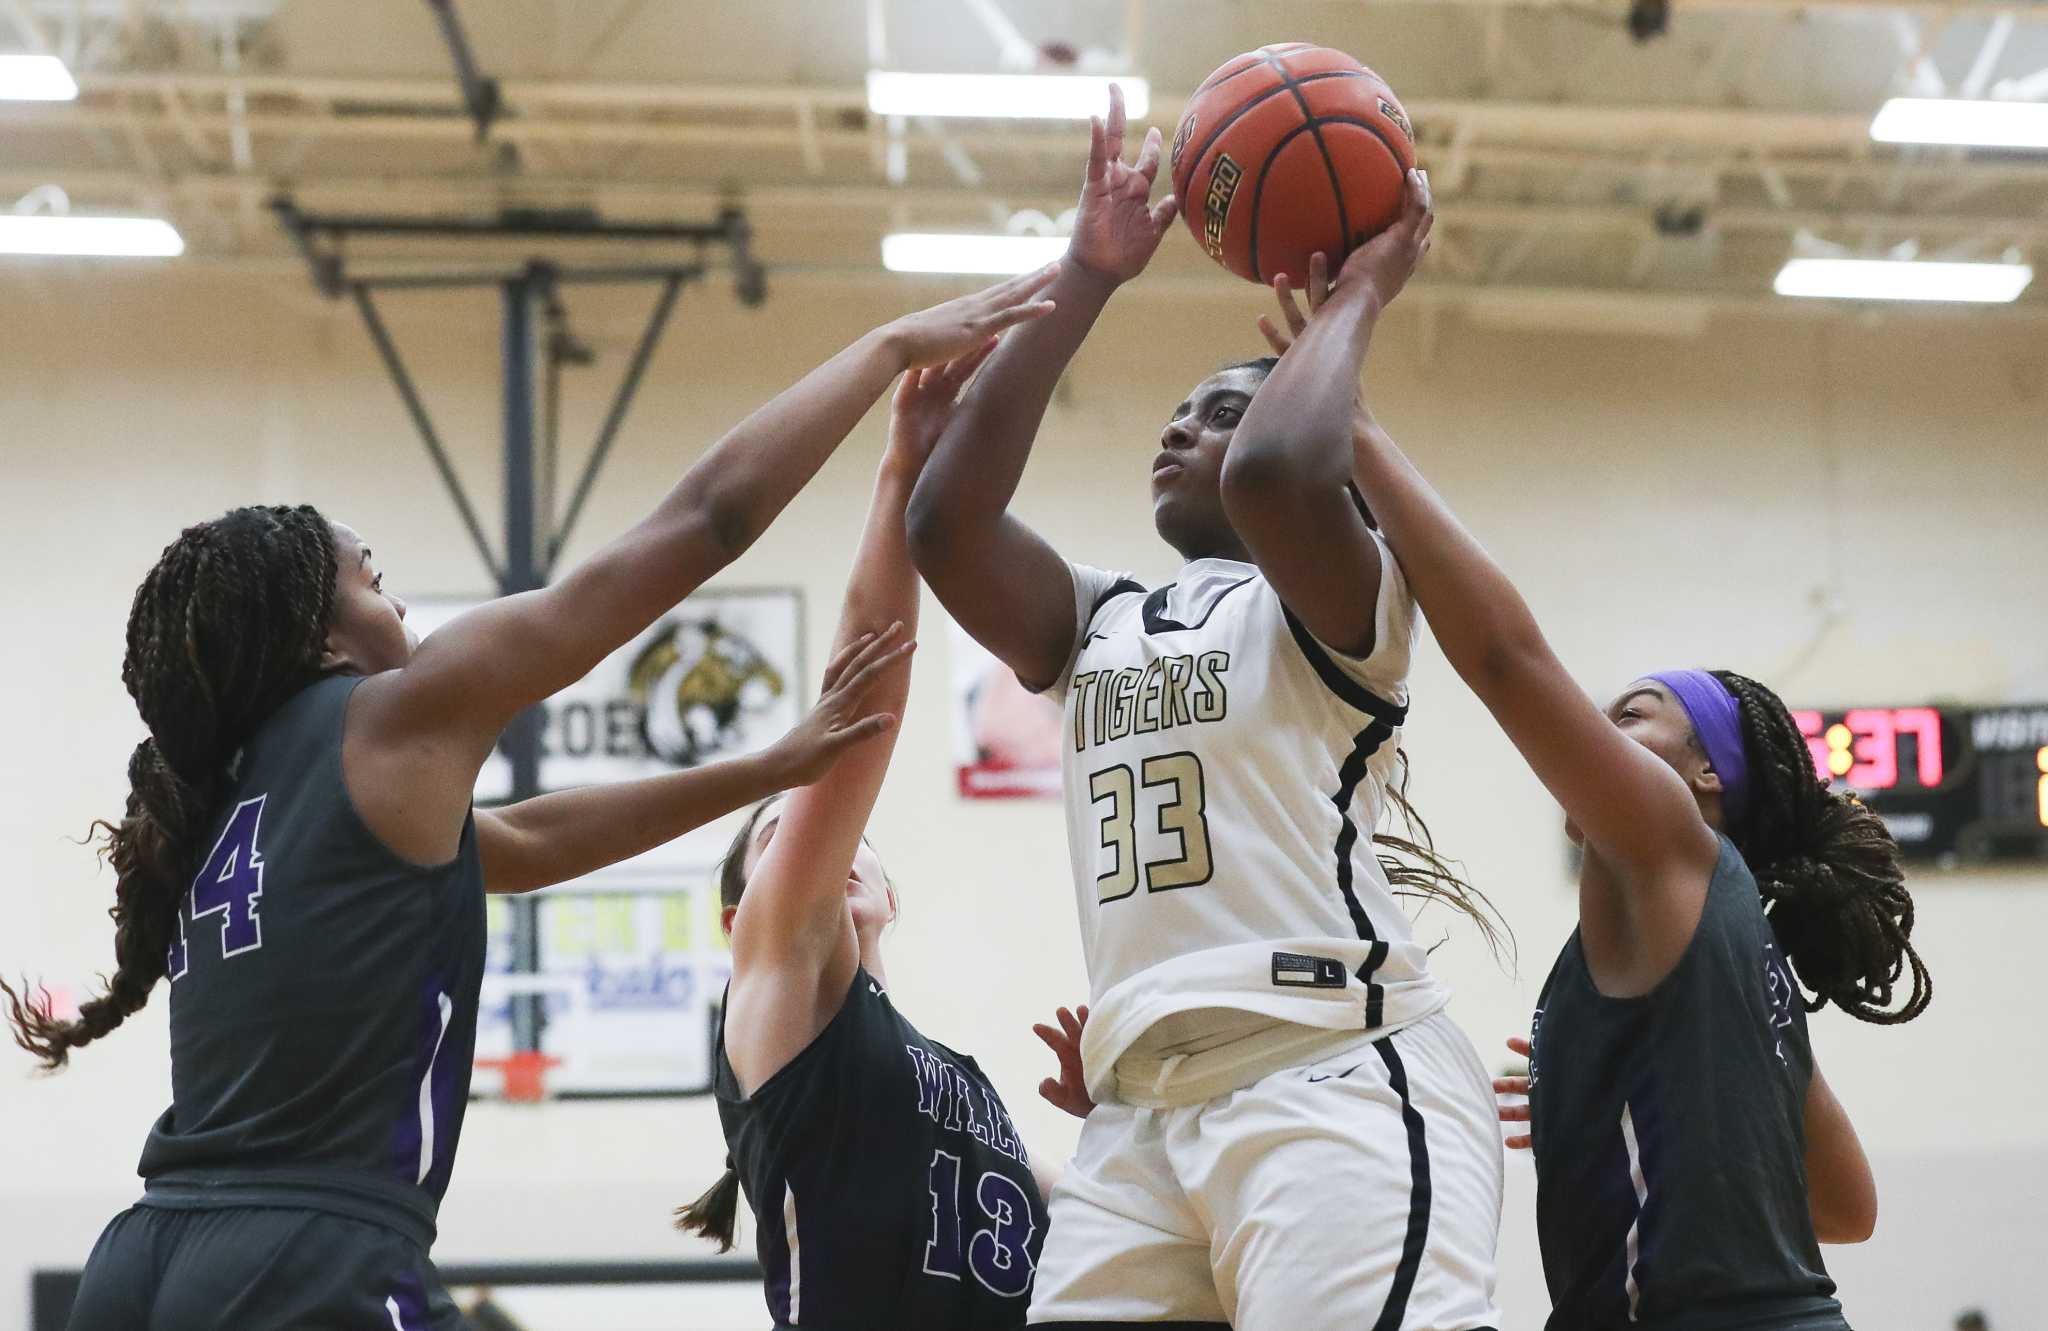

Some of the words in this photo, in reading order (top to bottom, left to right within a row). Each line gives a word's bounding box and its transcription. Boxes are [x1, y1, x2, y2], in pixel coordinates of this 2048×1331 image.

[1073, 650, 1230, 752] TIGERS
[1088, 750, 1214, 906] 33
[923, 1149, 1037, 1298] 13
